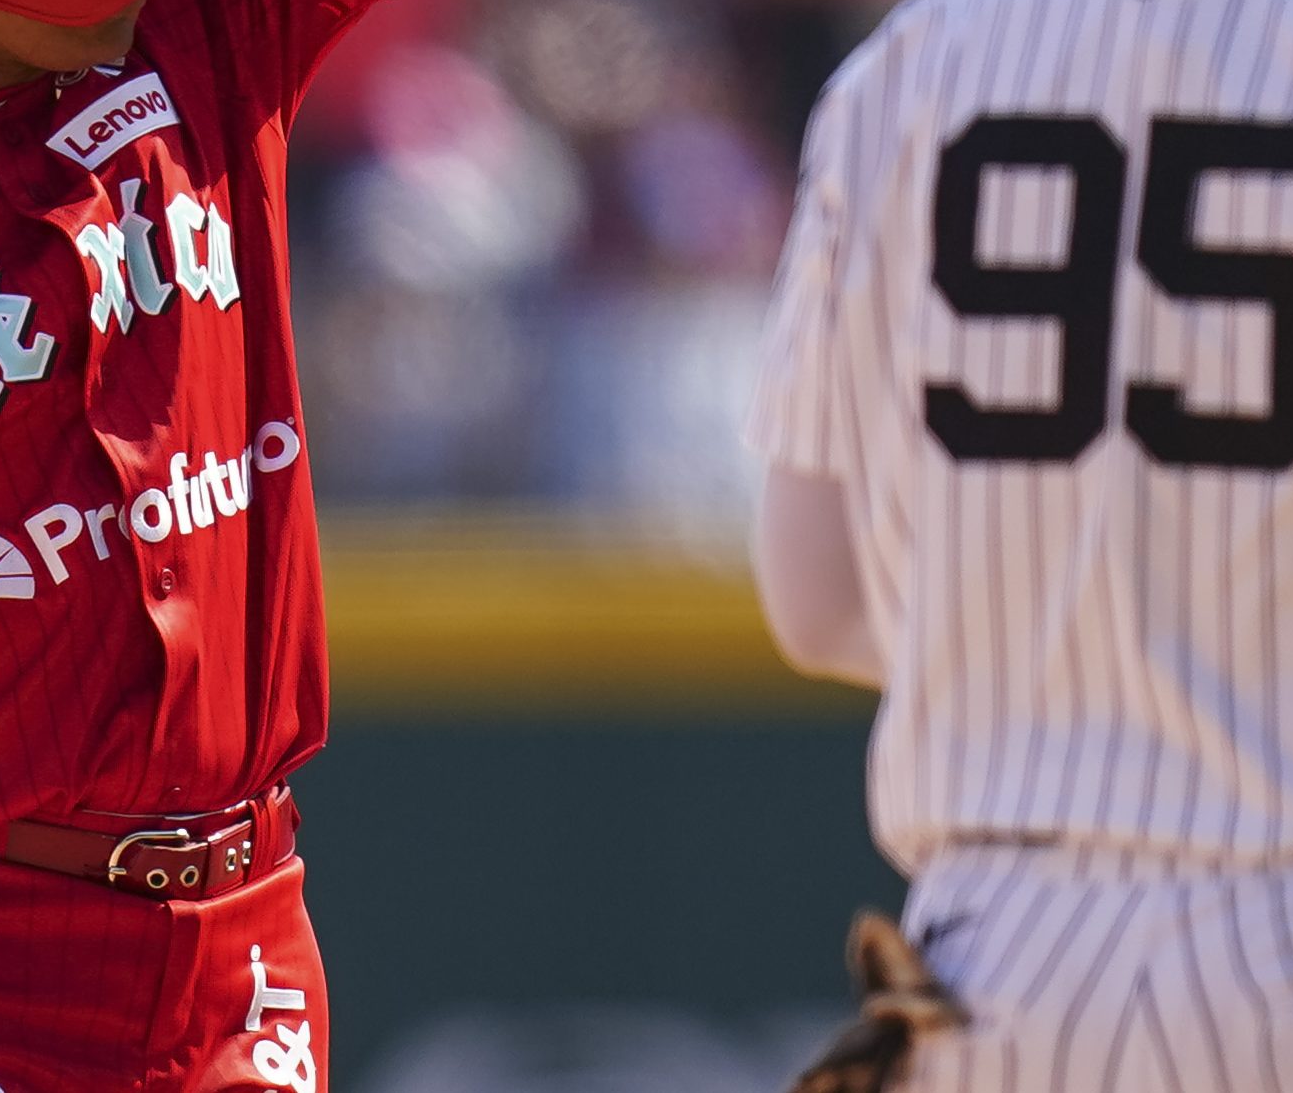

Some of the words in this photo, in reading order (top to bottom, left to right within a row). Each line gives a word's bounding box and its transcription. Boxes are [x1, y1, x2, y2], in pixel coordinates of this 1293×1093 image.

[64, 90, 167, 159] Lenovo
[24, 420, 300, 585] Profuturo
[245, 961, 317, 1093] &T
